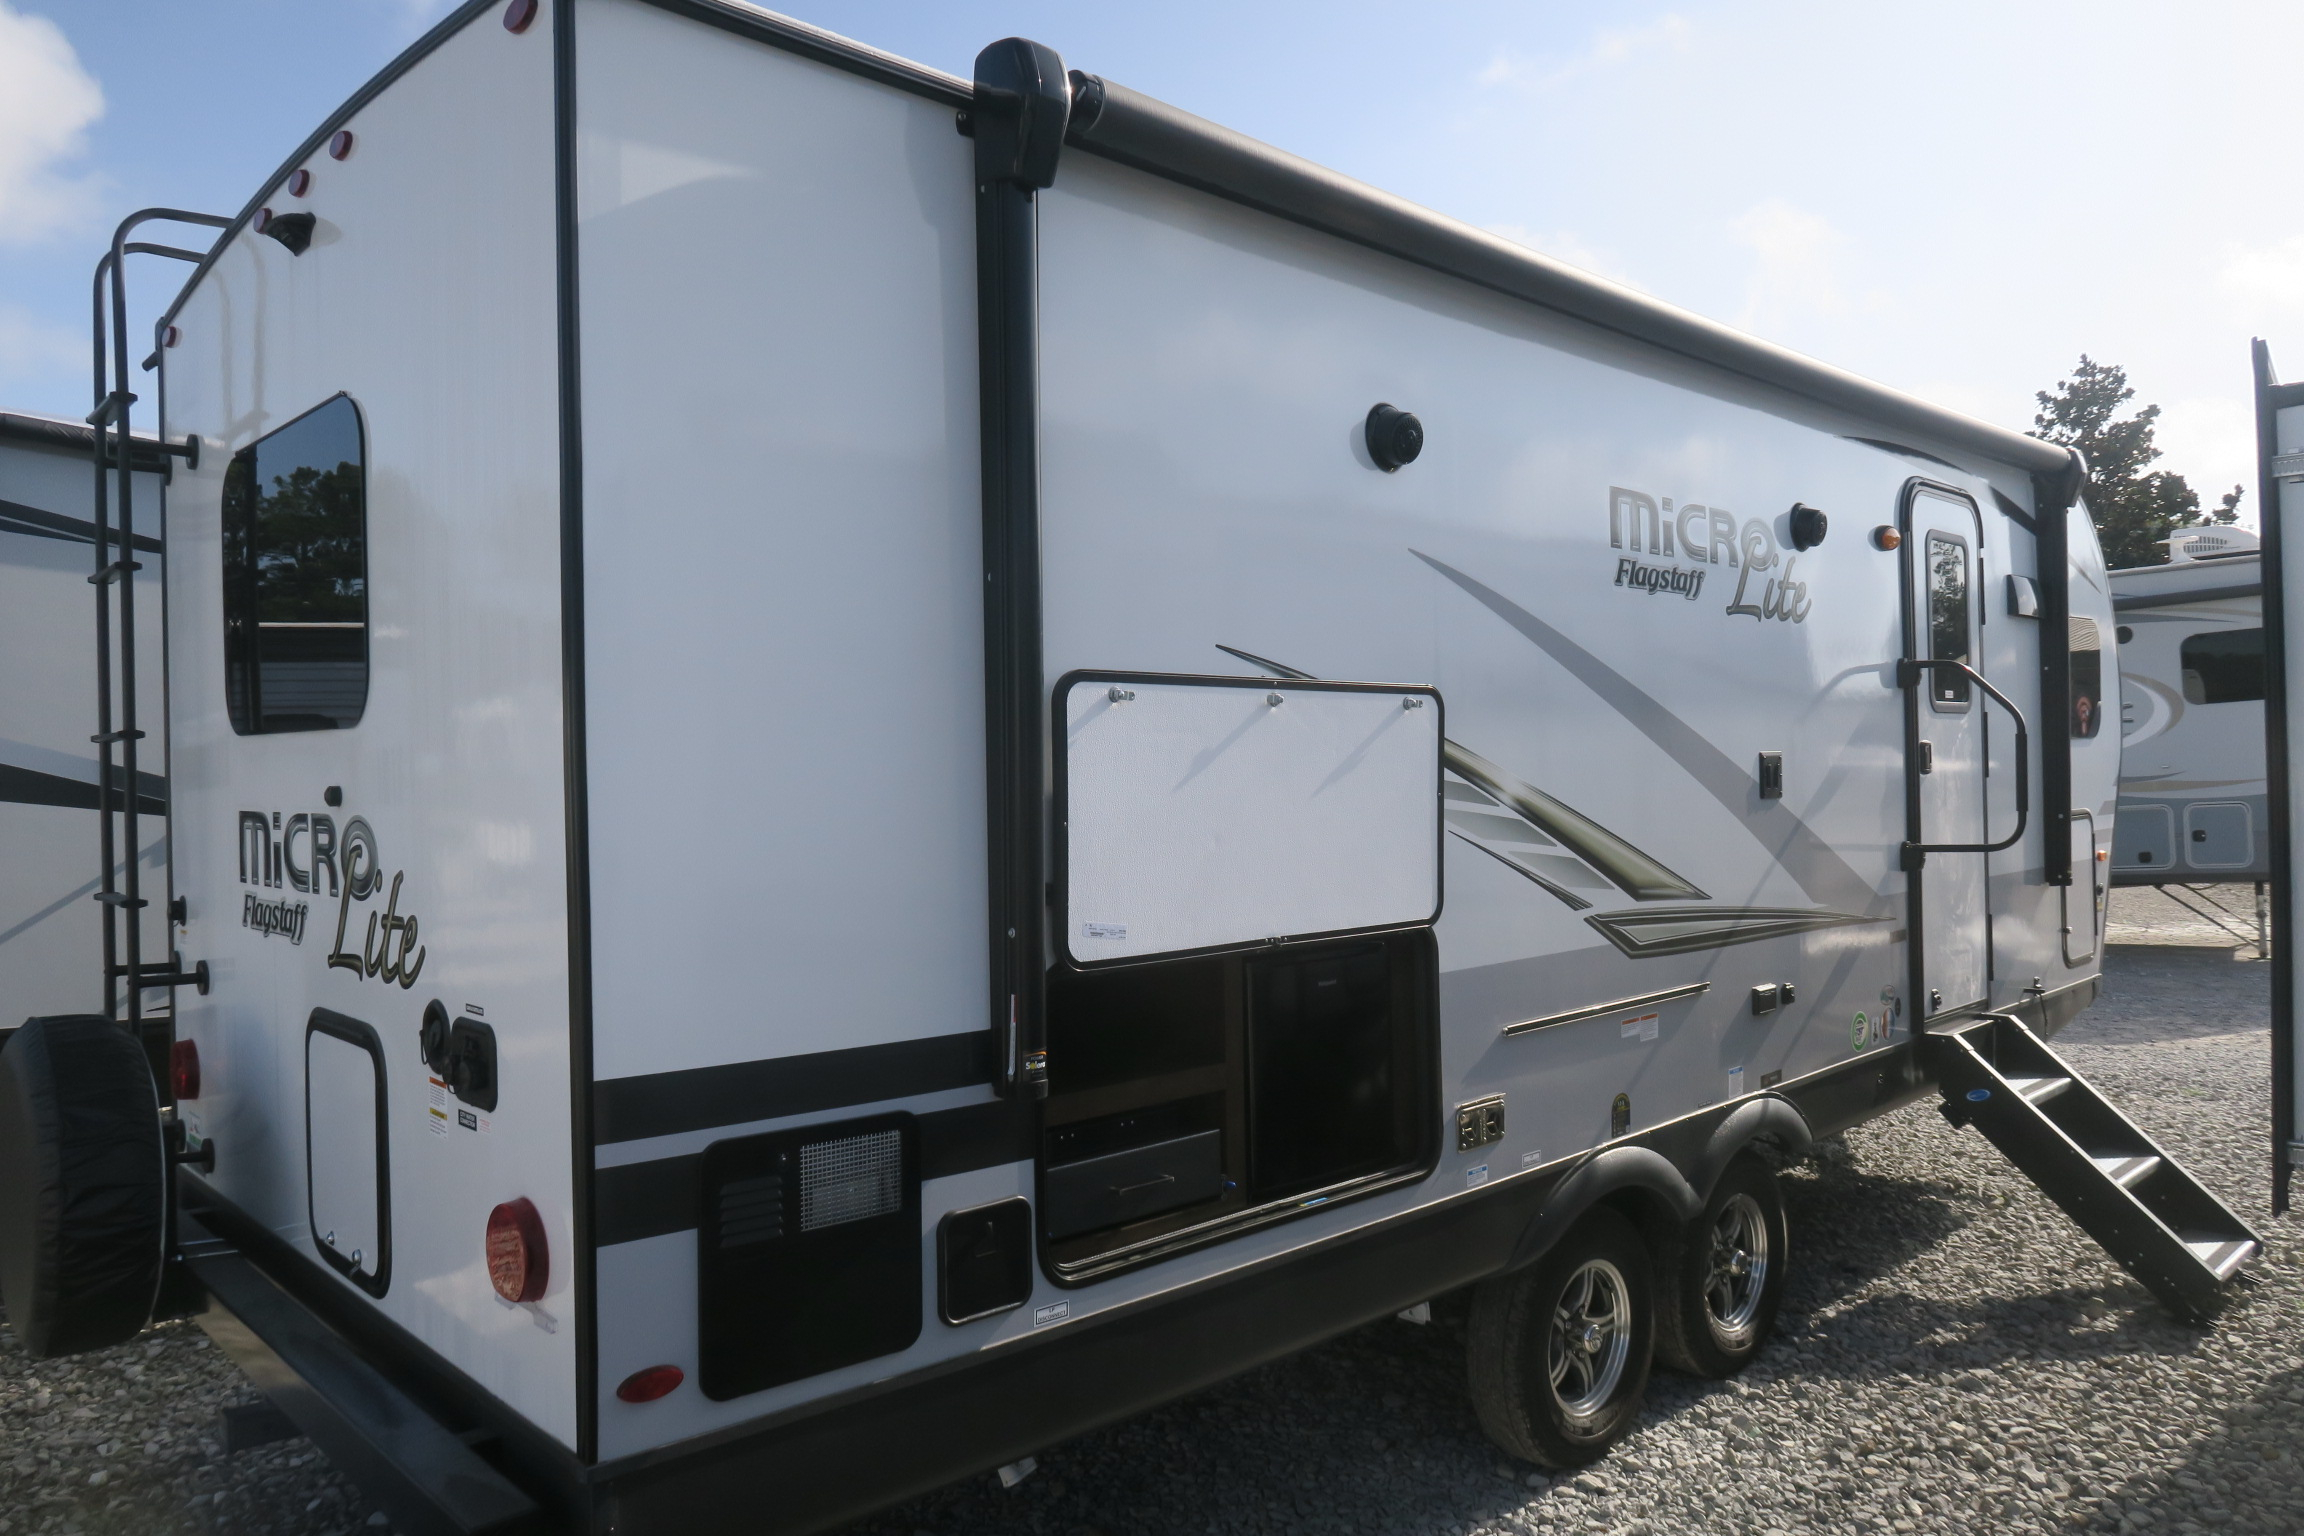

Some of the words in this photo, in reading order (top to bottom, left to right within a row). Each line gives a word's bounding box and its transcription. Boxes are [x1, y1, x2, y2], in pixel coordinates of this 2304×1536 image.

[1614, 557, 1705, 599] Flagstaff
[1726, 535, 1811, 624] Lite
[242, 893, 308, 944] Flagstaff
[327, 844, 426, 990] Lite
